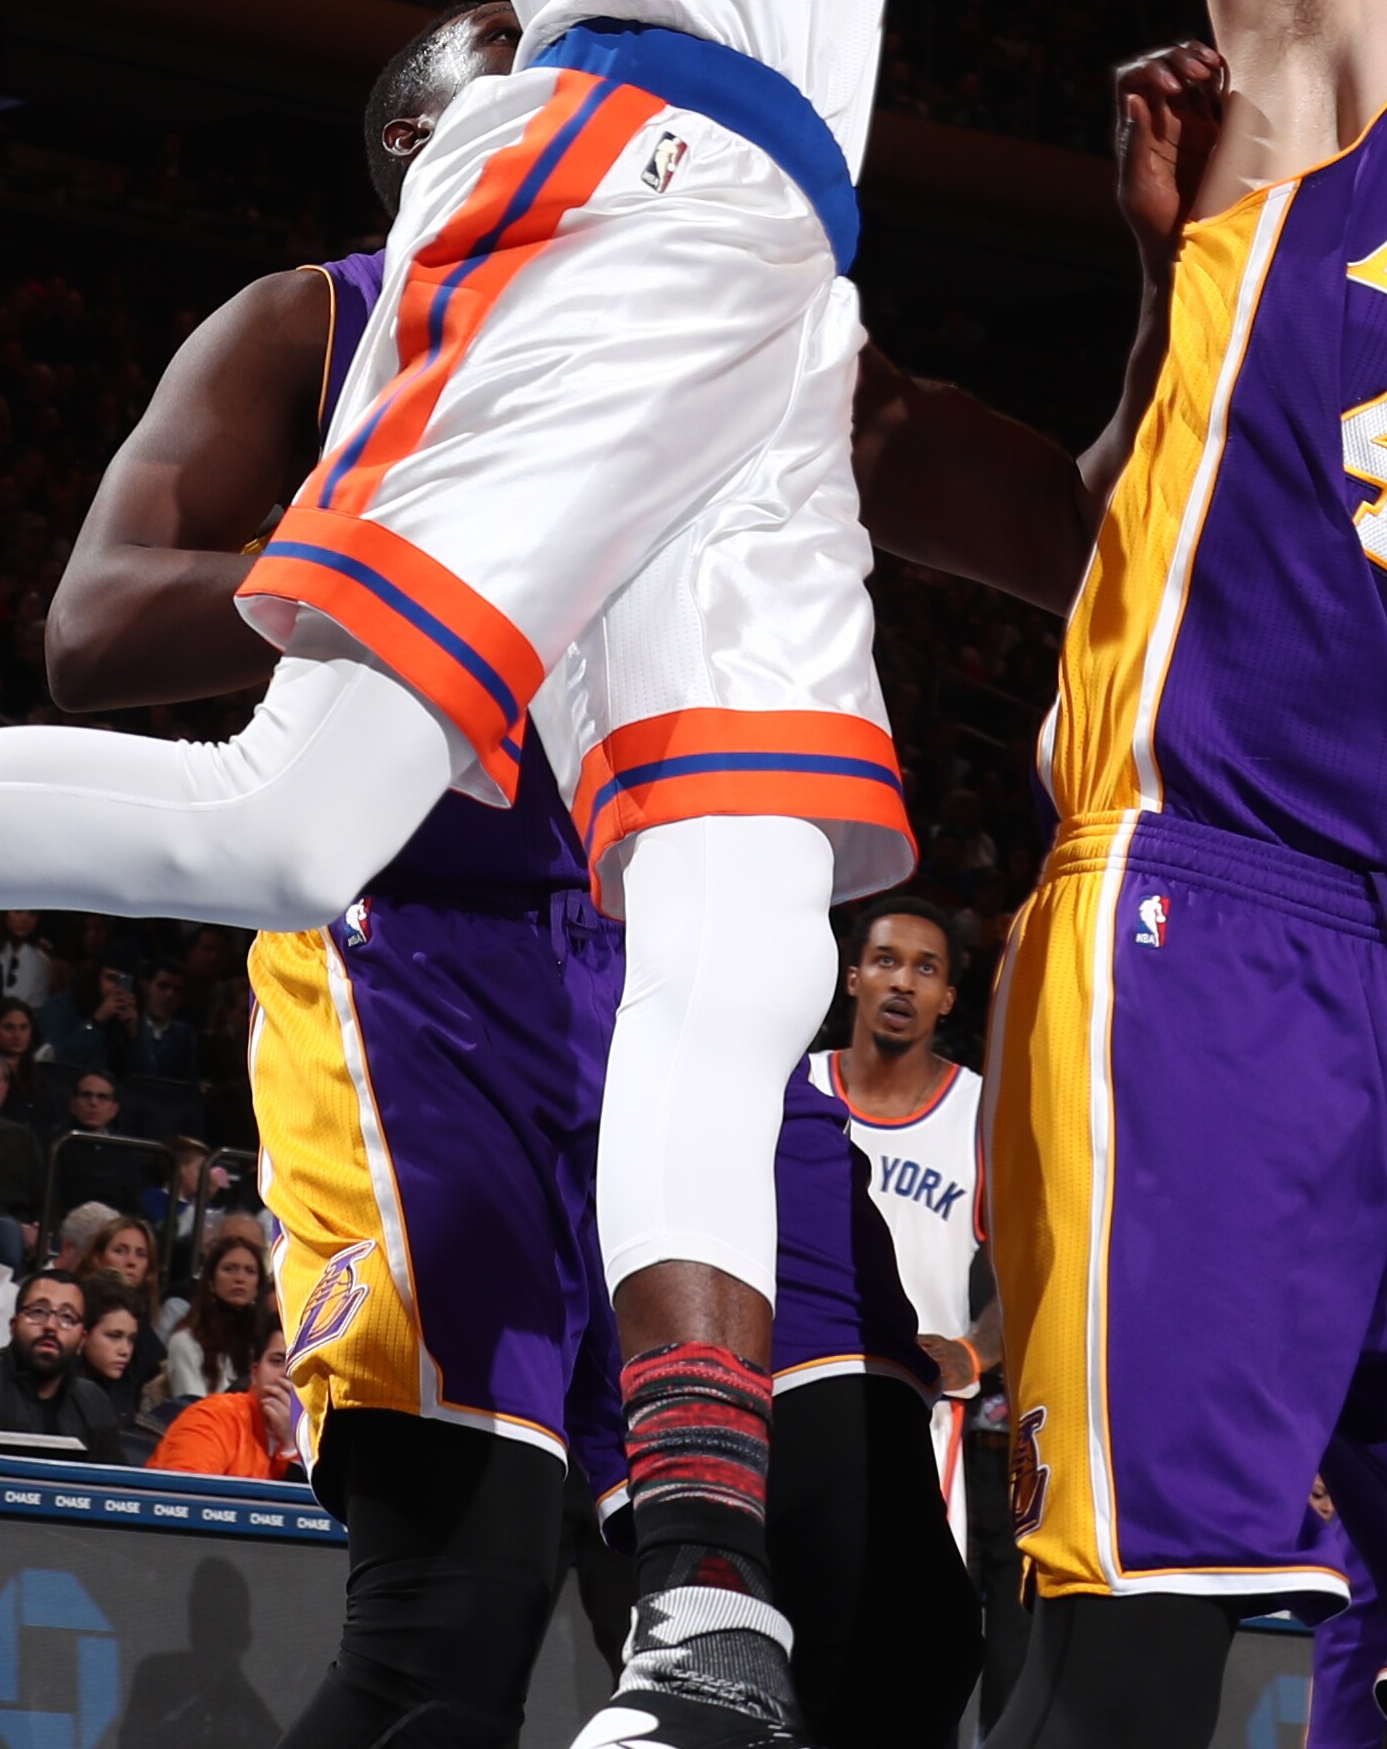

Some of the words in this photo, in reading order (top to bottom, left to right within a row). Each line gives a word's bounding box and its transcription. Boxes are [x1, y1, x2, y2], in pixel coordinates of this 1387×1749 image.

[880, 1155, 967, 1222] YORK
[4, 1490, 42, 1505] CHASE
[55, 1495, 91, 1510] CHASE
[104, 1499, 141, 1514] CHASE
[153, 1504, 189, 1518] CHASE
